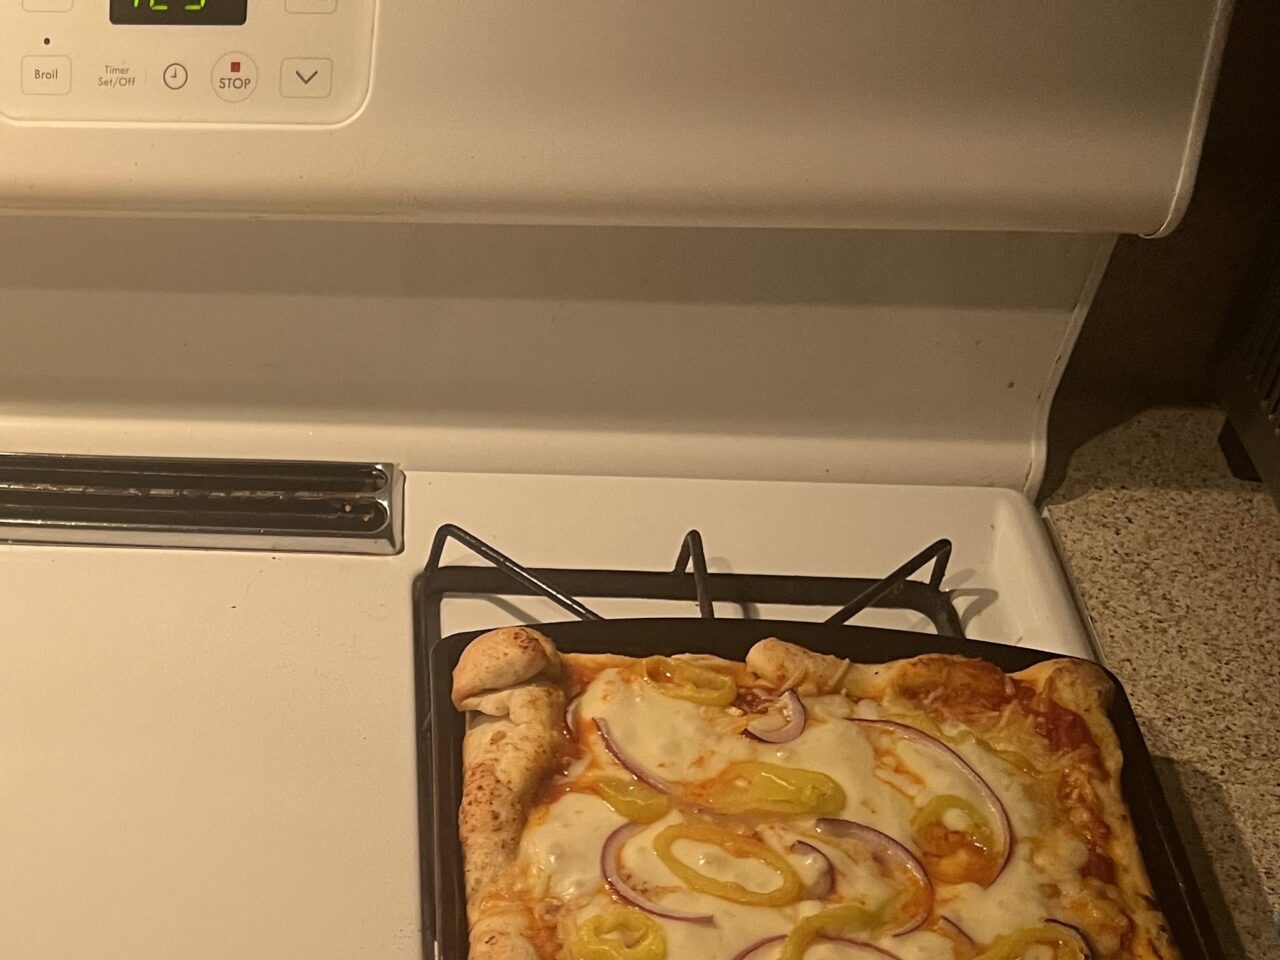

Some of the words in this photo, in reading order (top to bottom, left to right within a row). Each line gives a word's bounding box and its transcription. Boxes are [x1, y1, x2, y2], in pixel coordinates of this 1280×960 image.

[34, 69, 58, 80] Broil
[105, 65, 130, 75] Timer
[97, 76, 135, 88] Set/Off
[219, 77, 251, 89] STOP
